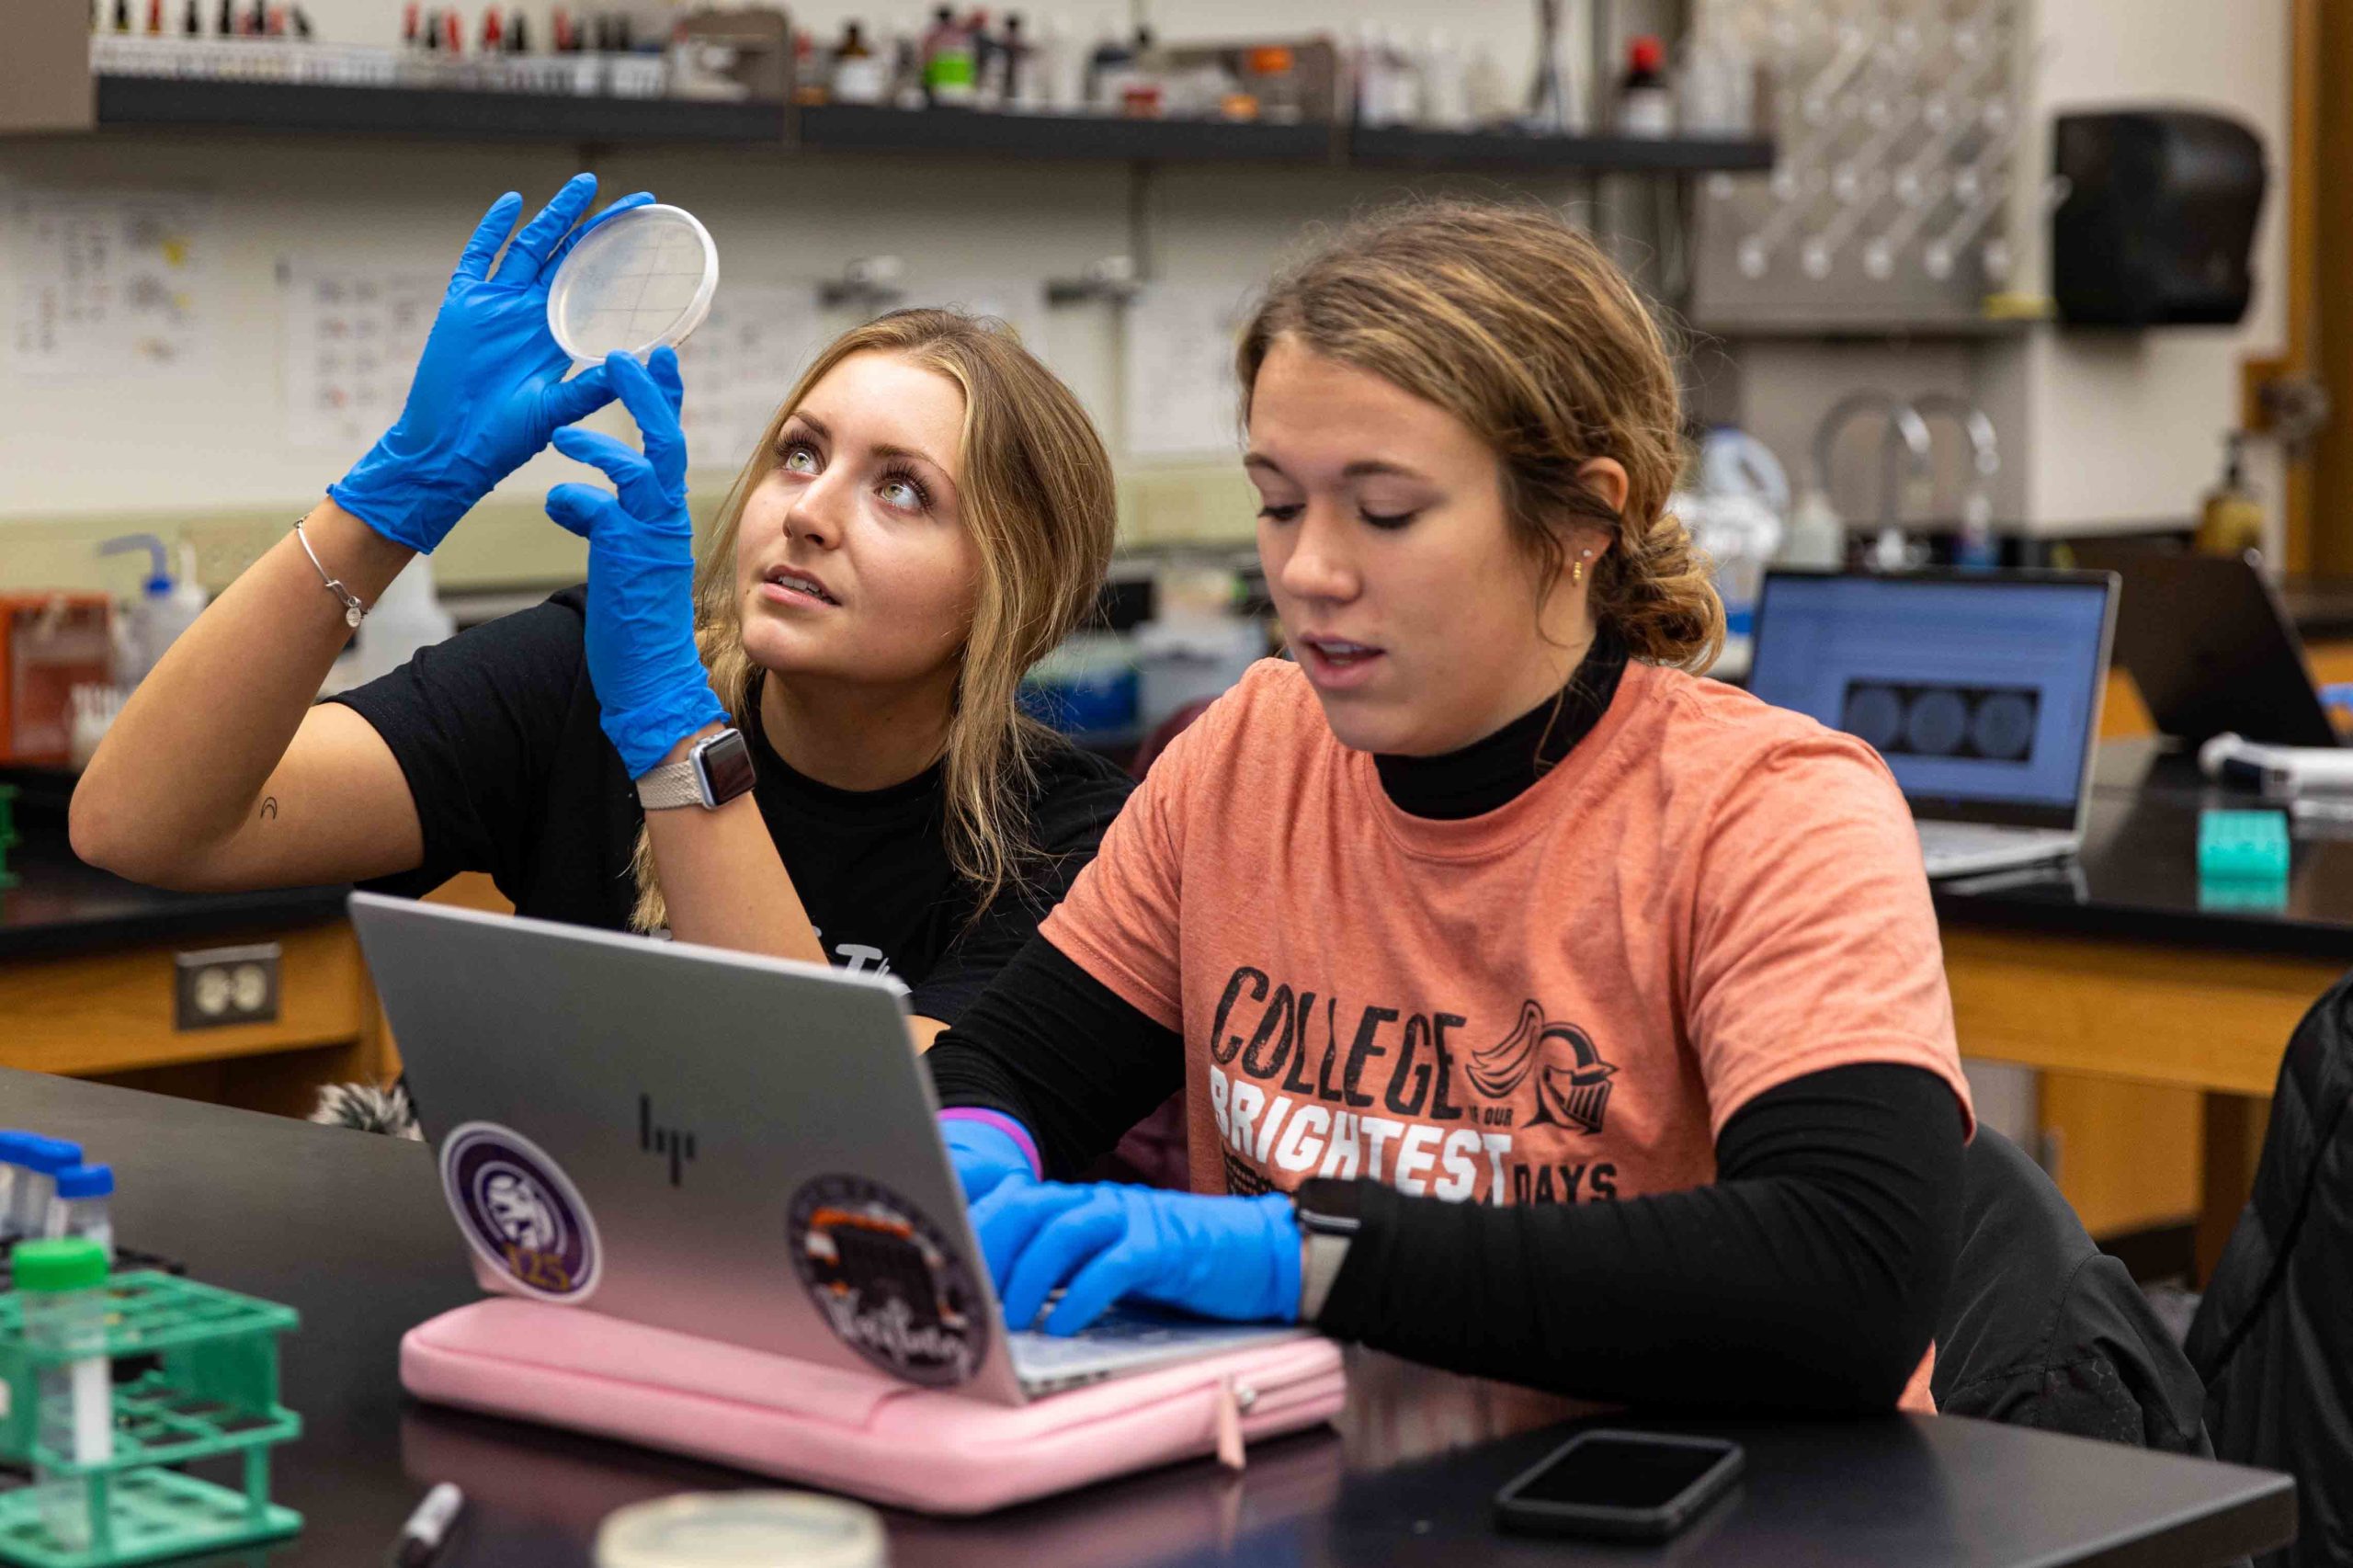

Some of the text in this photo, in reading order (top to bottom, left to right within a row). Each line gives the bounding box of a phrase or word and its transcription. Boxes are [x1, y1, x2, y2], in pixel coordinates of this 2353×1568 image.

[1211, 966, 1467, 1120] COLLEGE
[1210, 1064, 1513, 1207] BRIGHTEST
[1483, 1107, 1514, 1126] OUR
[1514, 1164, 1617, 1205] DAYS
[506, 1242, 570, 1290] 125
